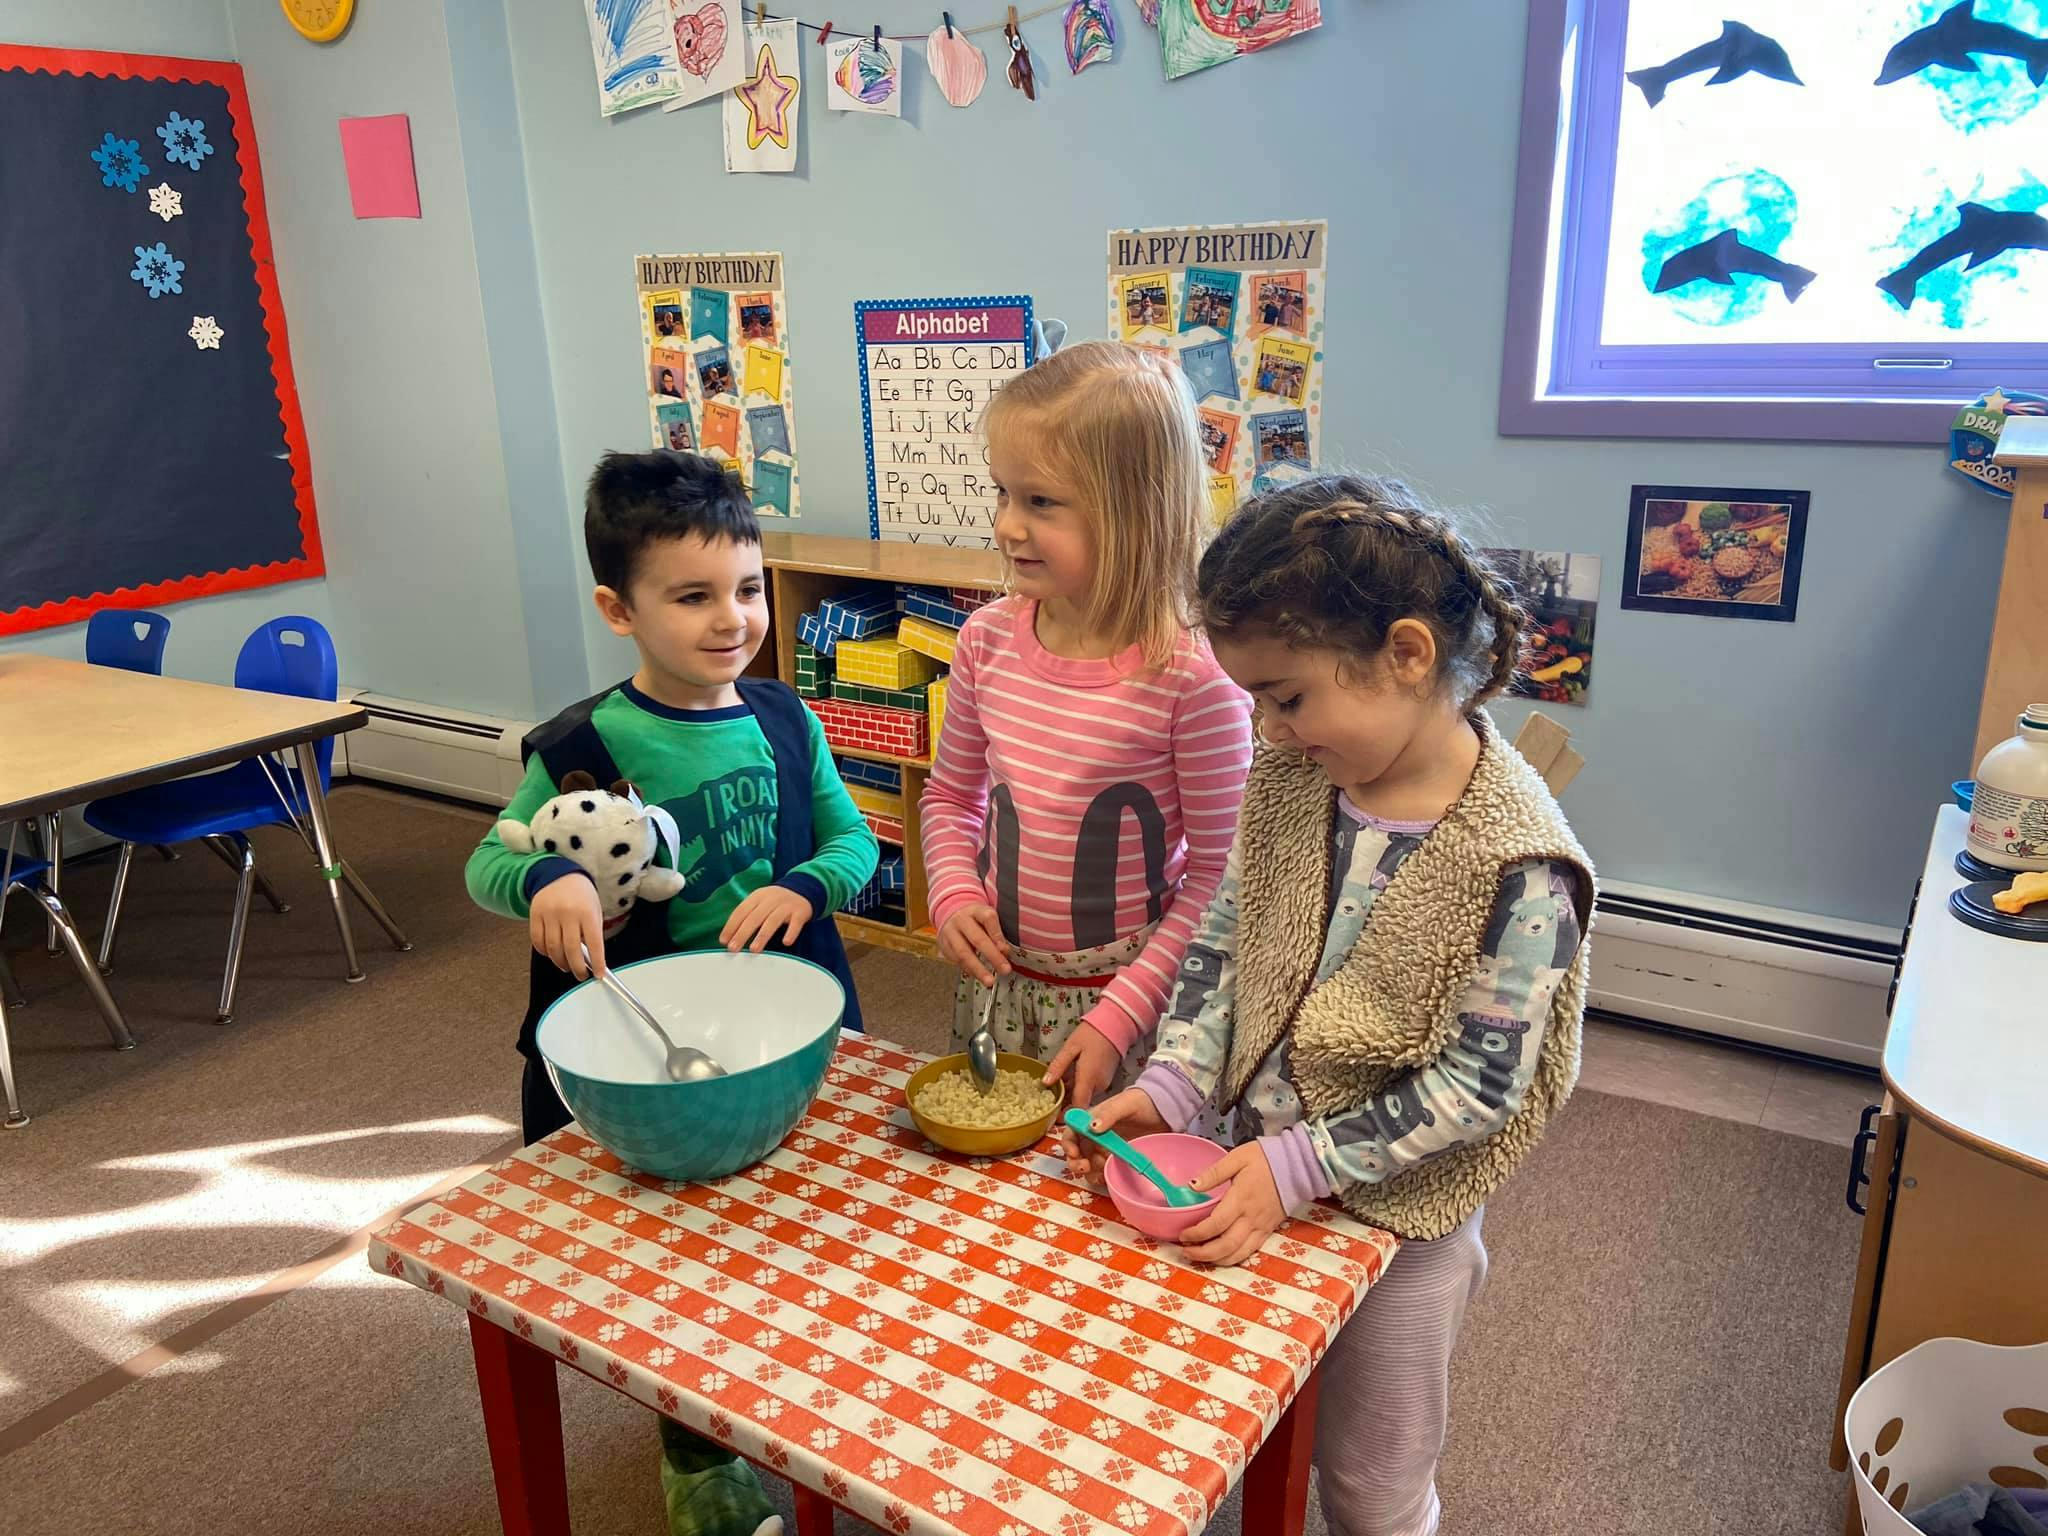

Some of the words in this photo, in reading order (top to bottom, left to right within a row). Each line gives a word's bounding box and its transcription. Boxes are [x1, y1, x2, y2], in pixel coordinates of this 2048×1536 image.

[1118, 236, 1190, 266] HAPPY
[1195, 230, 1315, 263] BIRTHDAY
[643, 261, 691, 284] HAPPY
[695, 260, 775, 283] BIRTHDAY
[896, 312, 989, 338] Alphabet
[874, 347, 901, 369] Aa
[915, 347, 941, 369] Bb
[952, 347, 977, 369] Cc
[991, 346, 1017, 369] Dd
[879, 379, 900, 400] Ee
[914, 378, 934, 400] Ff
[947, 379, 973, 412] Gg
[888, 411, 900, 432] Ii
[913, 411, 932, 443] Jj
[947, 411, 972, 433] Kk
[892, 442, 926, 464] Mm
[941, 444, 967, 465] Nn
[887, 472, 909, 502] Pp
[921, 473, 951, 504] Qq
[964, 475, 986, 496] Rr
[882, 501, 902, 522] Tt
[917, 503, 940, 525] Uu
[953, 505, 976, 526] Vv
[704, 789, 715, 828] I
[720, 825, 739, 855] IN
[741, 813, 766, 849] MY
